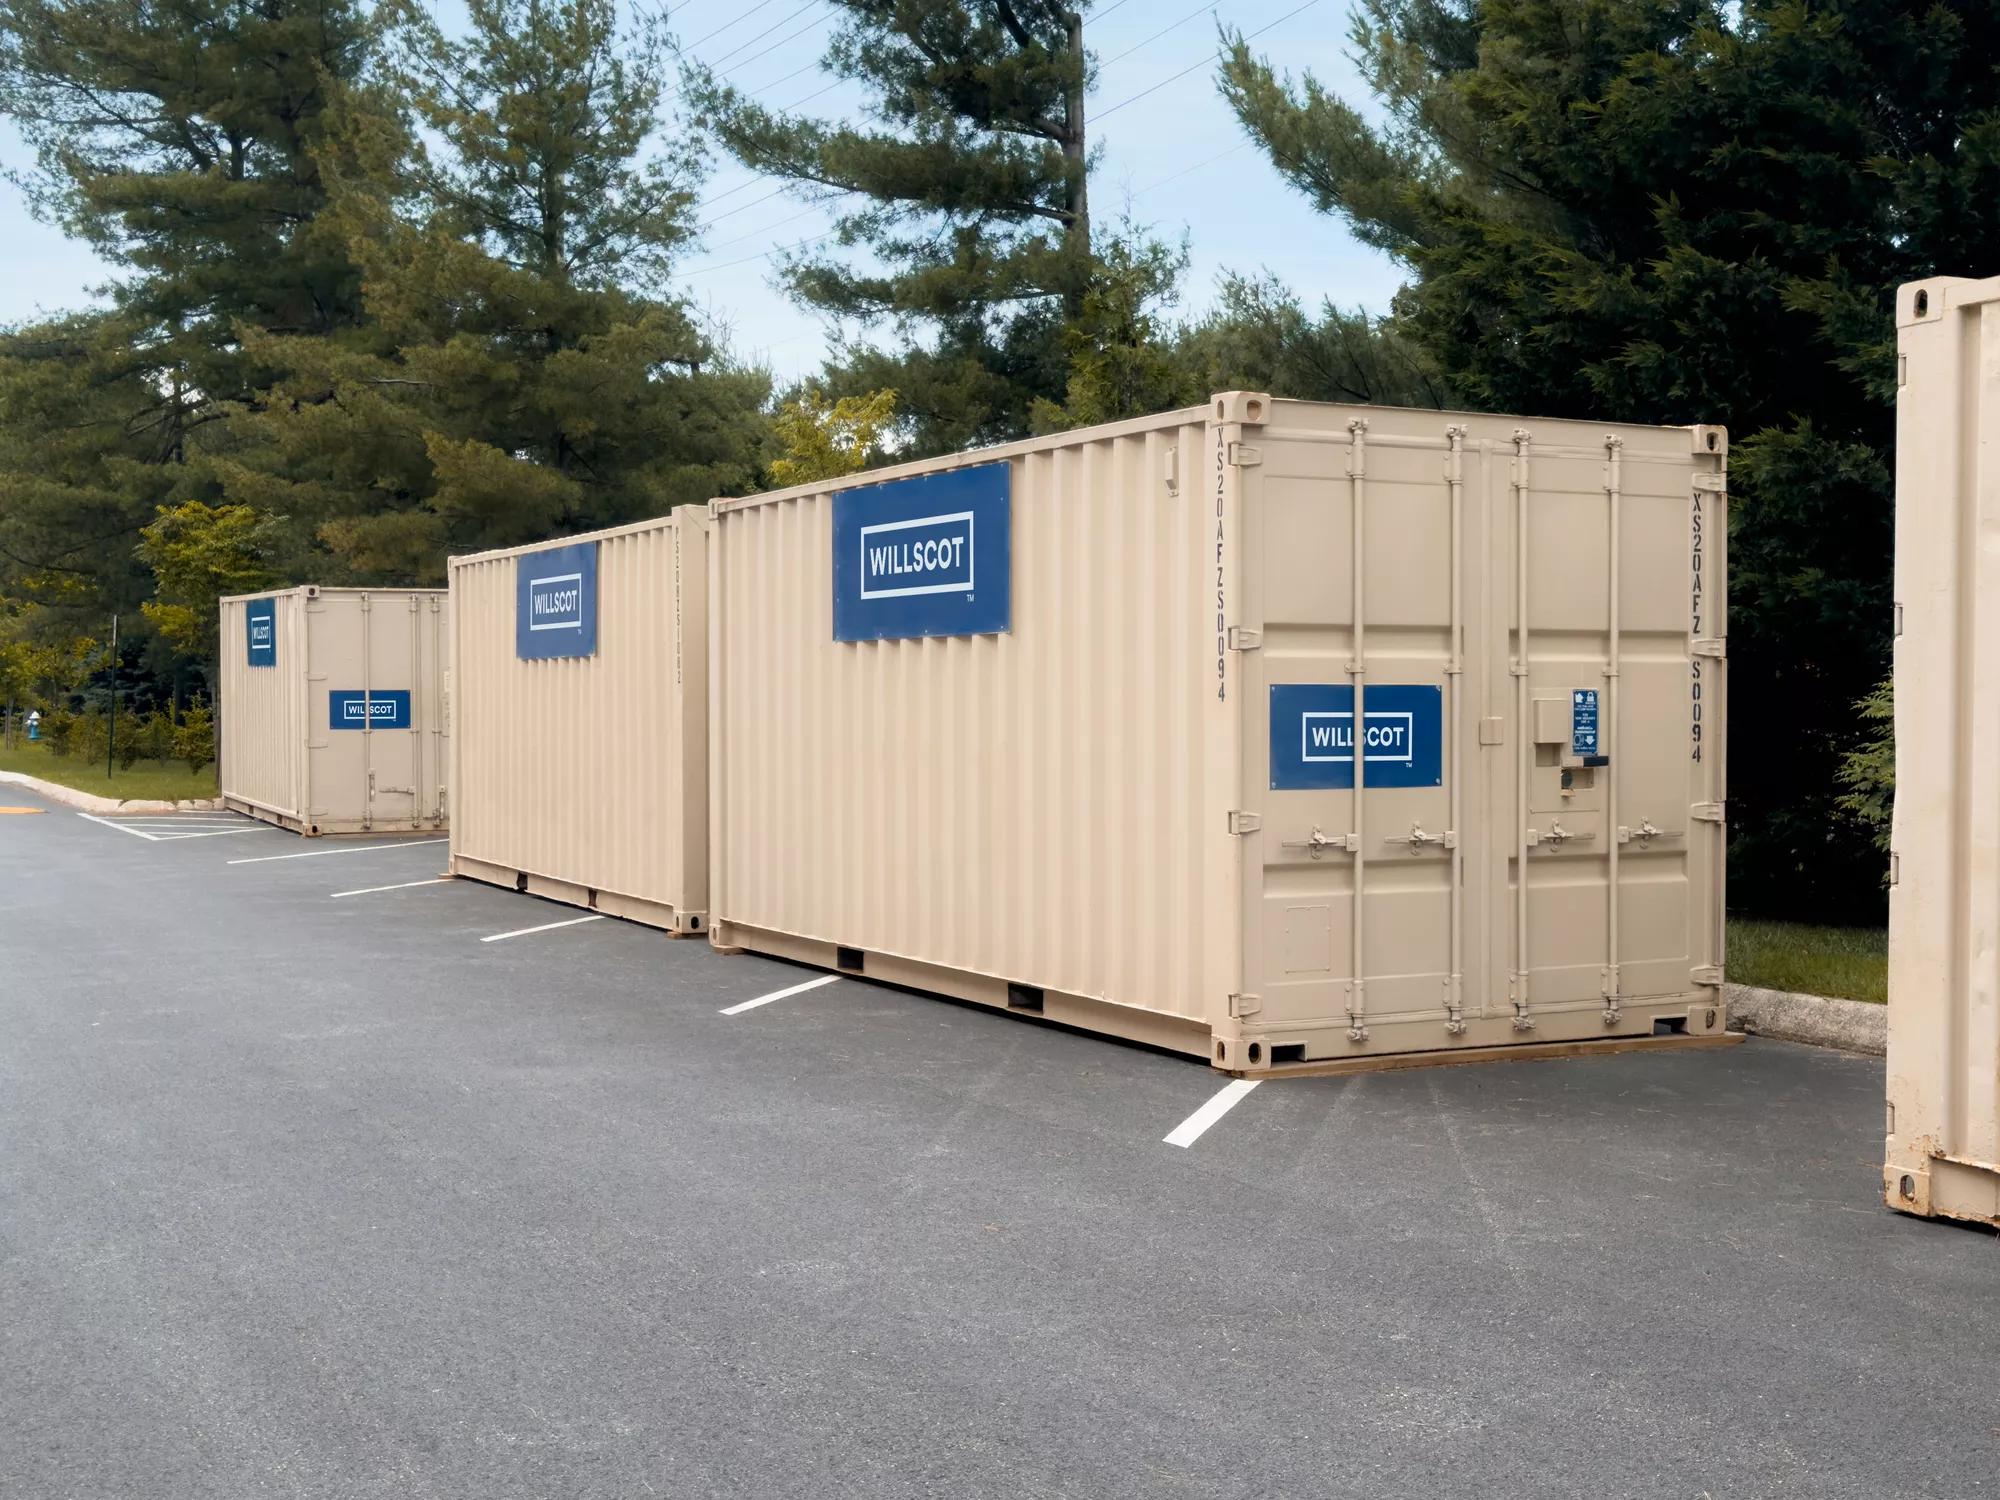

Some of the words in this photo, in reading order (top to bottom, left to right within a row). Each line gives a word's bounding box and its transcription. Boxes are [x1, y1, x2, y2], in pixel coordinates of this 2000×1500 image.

[869, 536, 964, 577] WILLSCOT
[1217, 427, 1225, 702] XS20AFZS0094
[1693, 493, 1702, 634] XS20AFZ
[534, 589, 578, 615] WILLSCOT
[348, 705, 392, 714] WILSCOT
[1692, 661, 1701, 763] S0094
